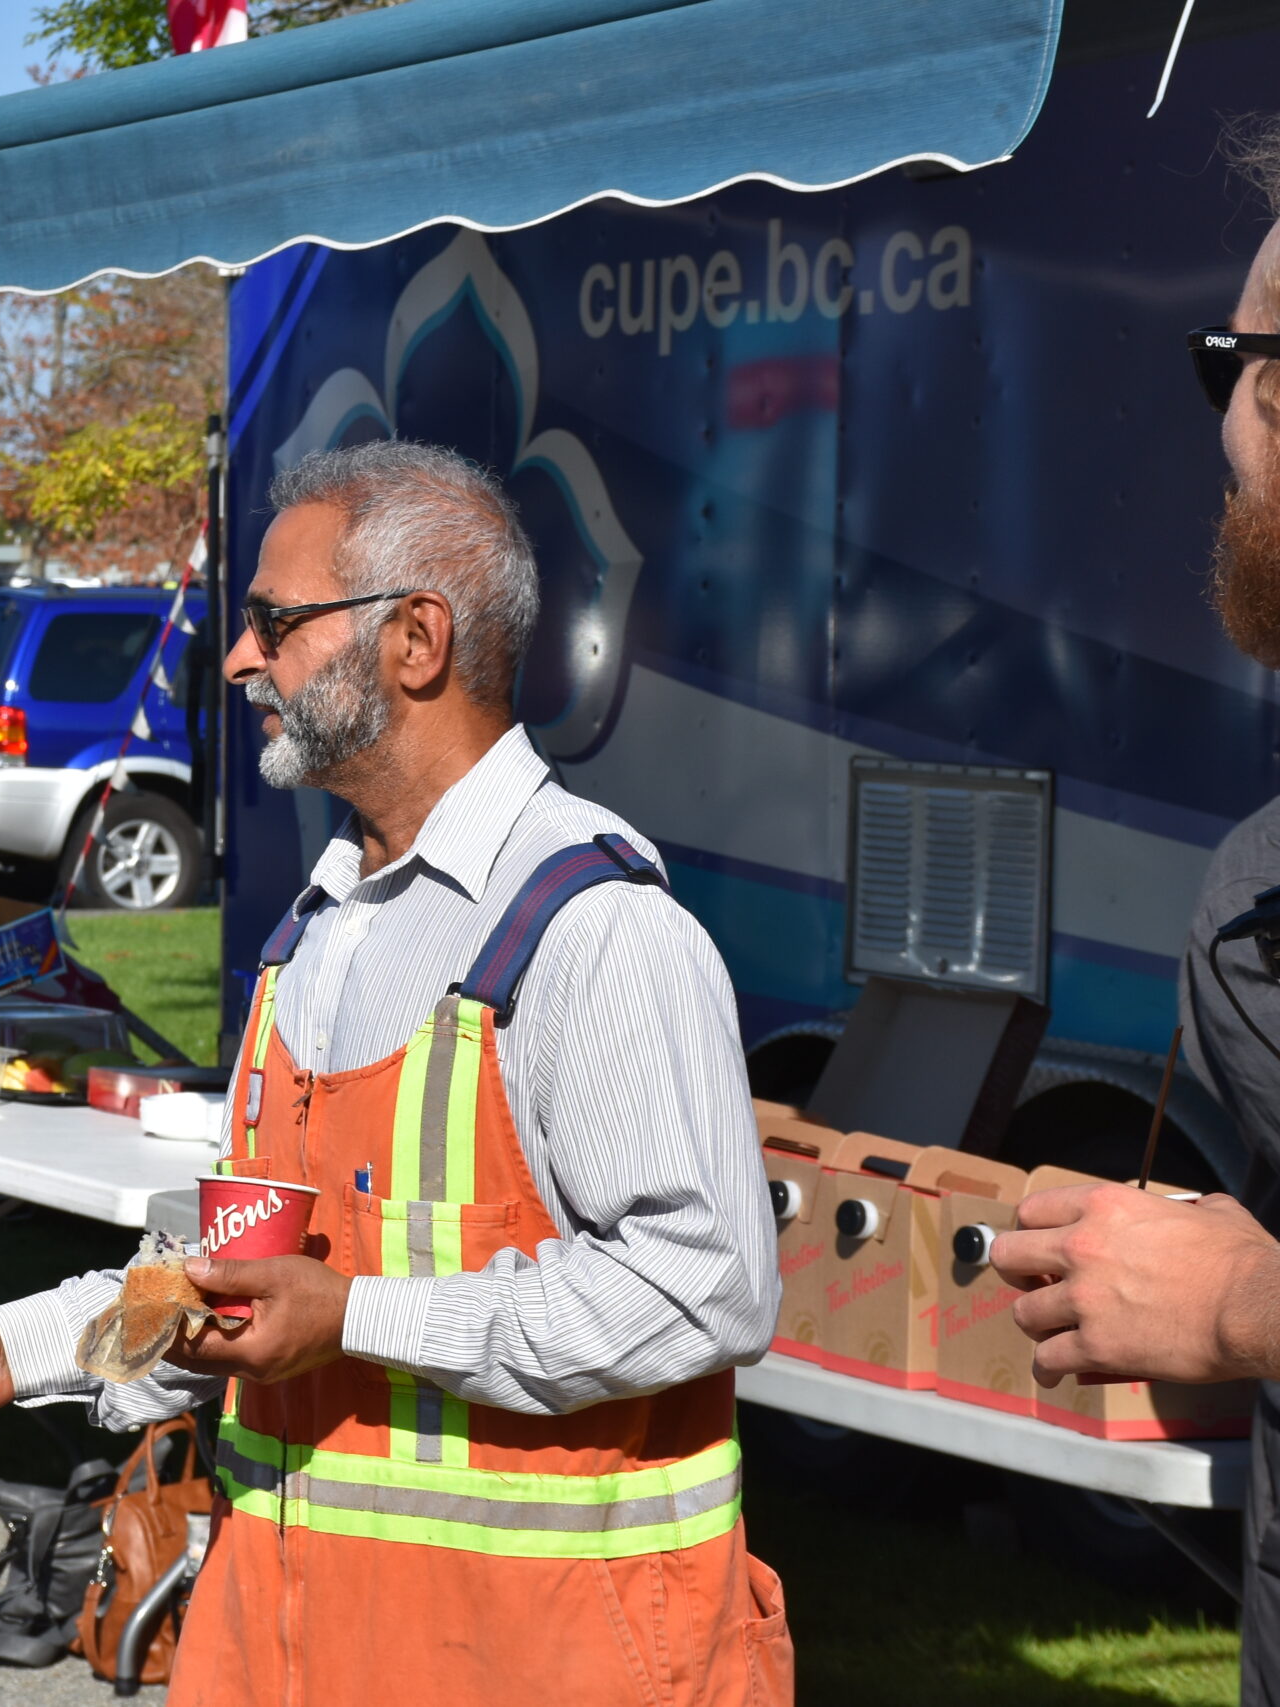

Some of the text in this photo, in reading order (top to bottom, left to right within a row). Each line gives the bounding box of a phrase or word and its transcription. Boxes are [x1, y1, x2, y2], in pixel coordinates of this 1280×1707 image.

[579, 218, 972, 356] cupe.bc.ca
[1205, 336, 1237, 348] OAKLEY
[200, 1188, 283, 1258] ortons
